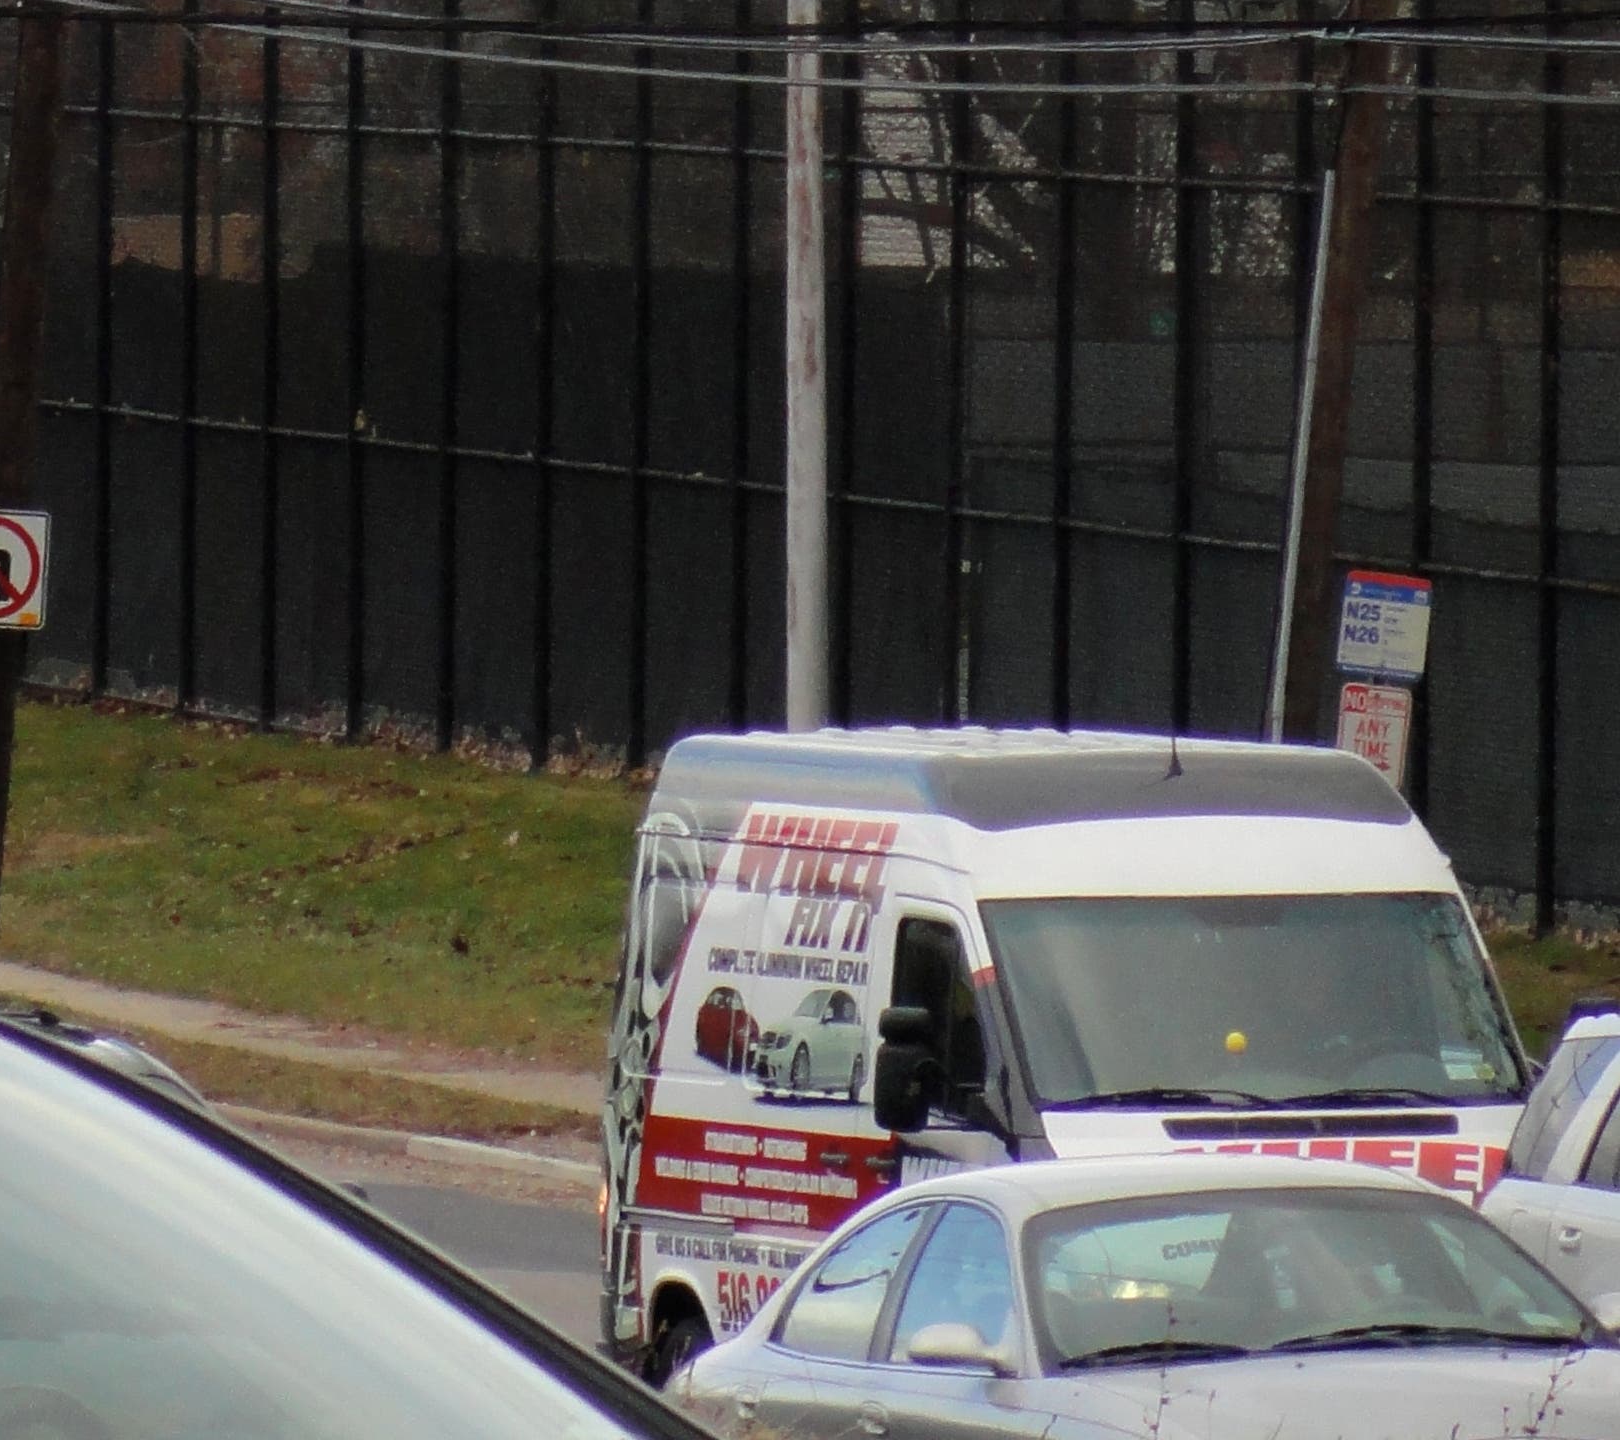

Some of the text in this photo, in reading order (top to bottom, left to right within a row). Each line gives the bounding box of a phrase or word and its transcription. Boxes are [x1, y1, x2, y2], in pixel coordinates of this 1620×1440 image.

[1346, 602, 1381, 622] N25
[1344, 624, 1379, 645] N26
[1345, 690, 1366, 711] NO
[1356, 719, 1390, 737] ANY
[1354, 737, 1390, 759] TIME
[736, 814, 900, 912] WHEEL
[784, 899, 874, 953] FIX IT
[804, 957, 834, 982] WHEEL
[836, 960, 868, 985] REPAIR
[675, 1235, 685, 1257] US
[693, 1237, 711, 1260] CALL
[712, 1239, 727, 1261] FOR
